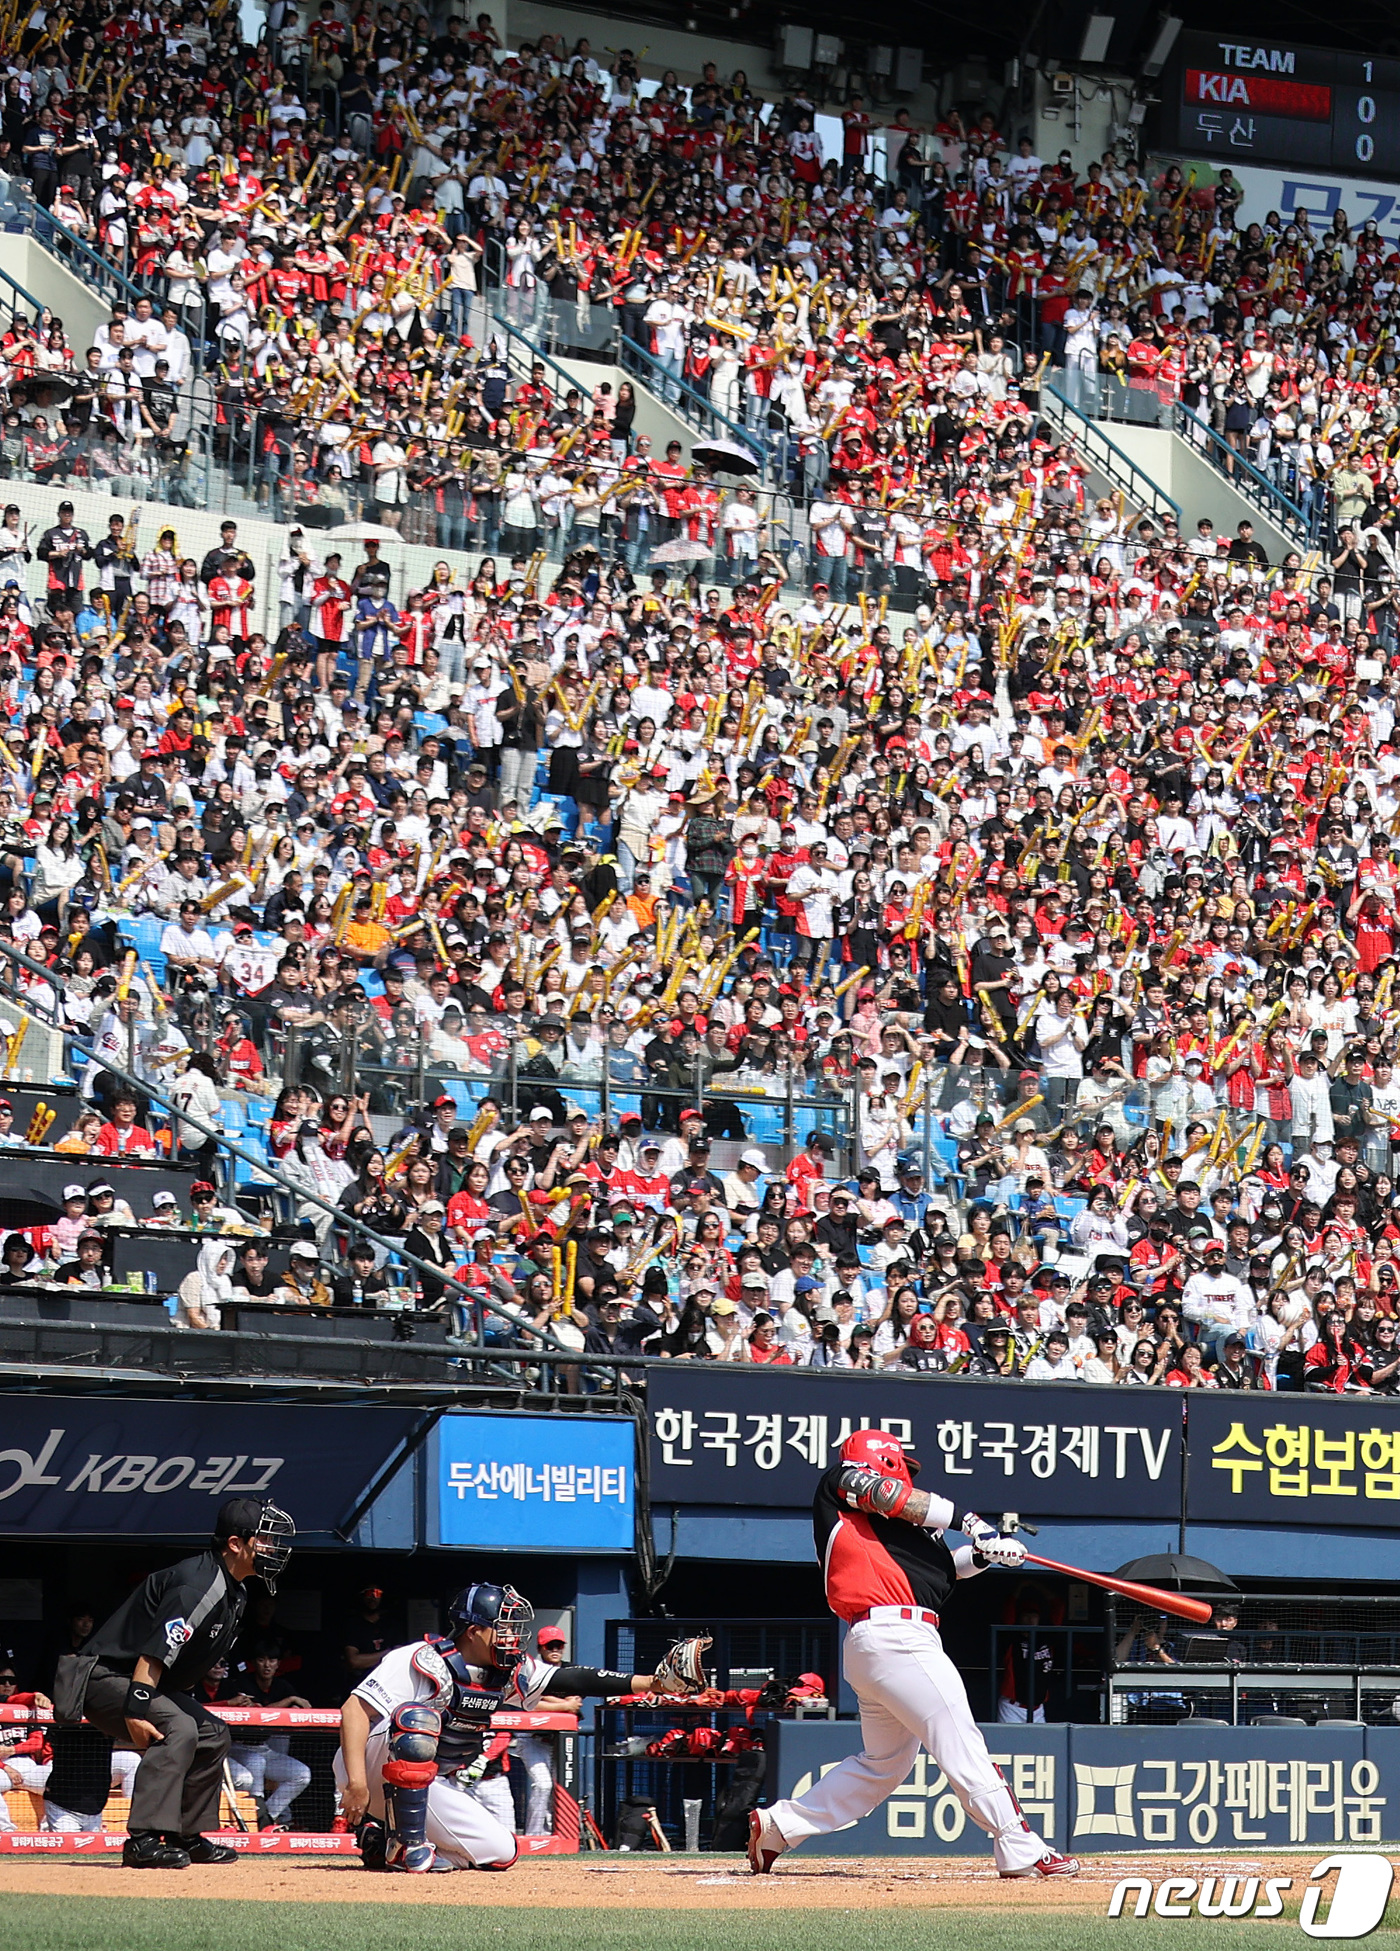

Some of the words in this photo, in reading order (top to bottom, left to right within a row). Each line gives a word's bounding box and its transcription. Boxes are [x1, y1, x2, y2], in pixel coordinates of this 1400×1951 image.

[1218, 43, 1296, 74] TEAM
[1362, 61, 1374, 83] 1
[1199, 74, 1250, 105] KIA
[1357, 96, 1376, 123] 0
[1196, 113, 1257, 148] 두산
[1355, 134, 1375, 162] 0
[241, 962, 264, 985] 34
[936, 1419, 1172, 1480] 한국경제TV
[1211, 1422, 1400, 1500] 수협보험
[448, 1462, 627, 1504] 두산에너빌리티
[461, 1696, 498, 1711] 두산퓨얼셀
[887, 1753, 1055, 1842] 금강택
[1136, 1759, 1388, 1845] 금강펜테리움
